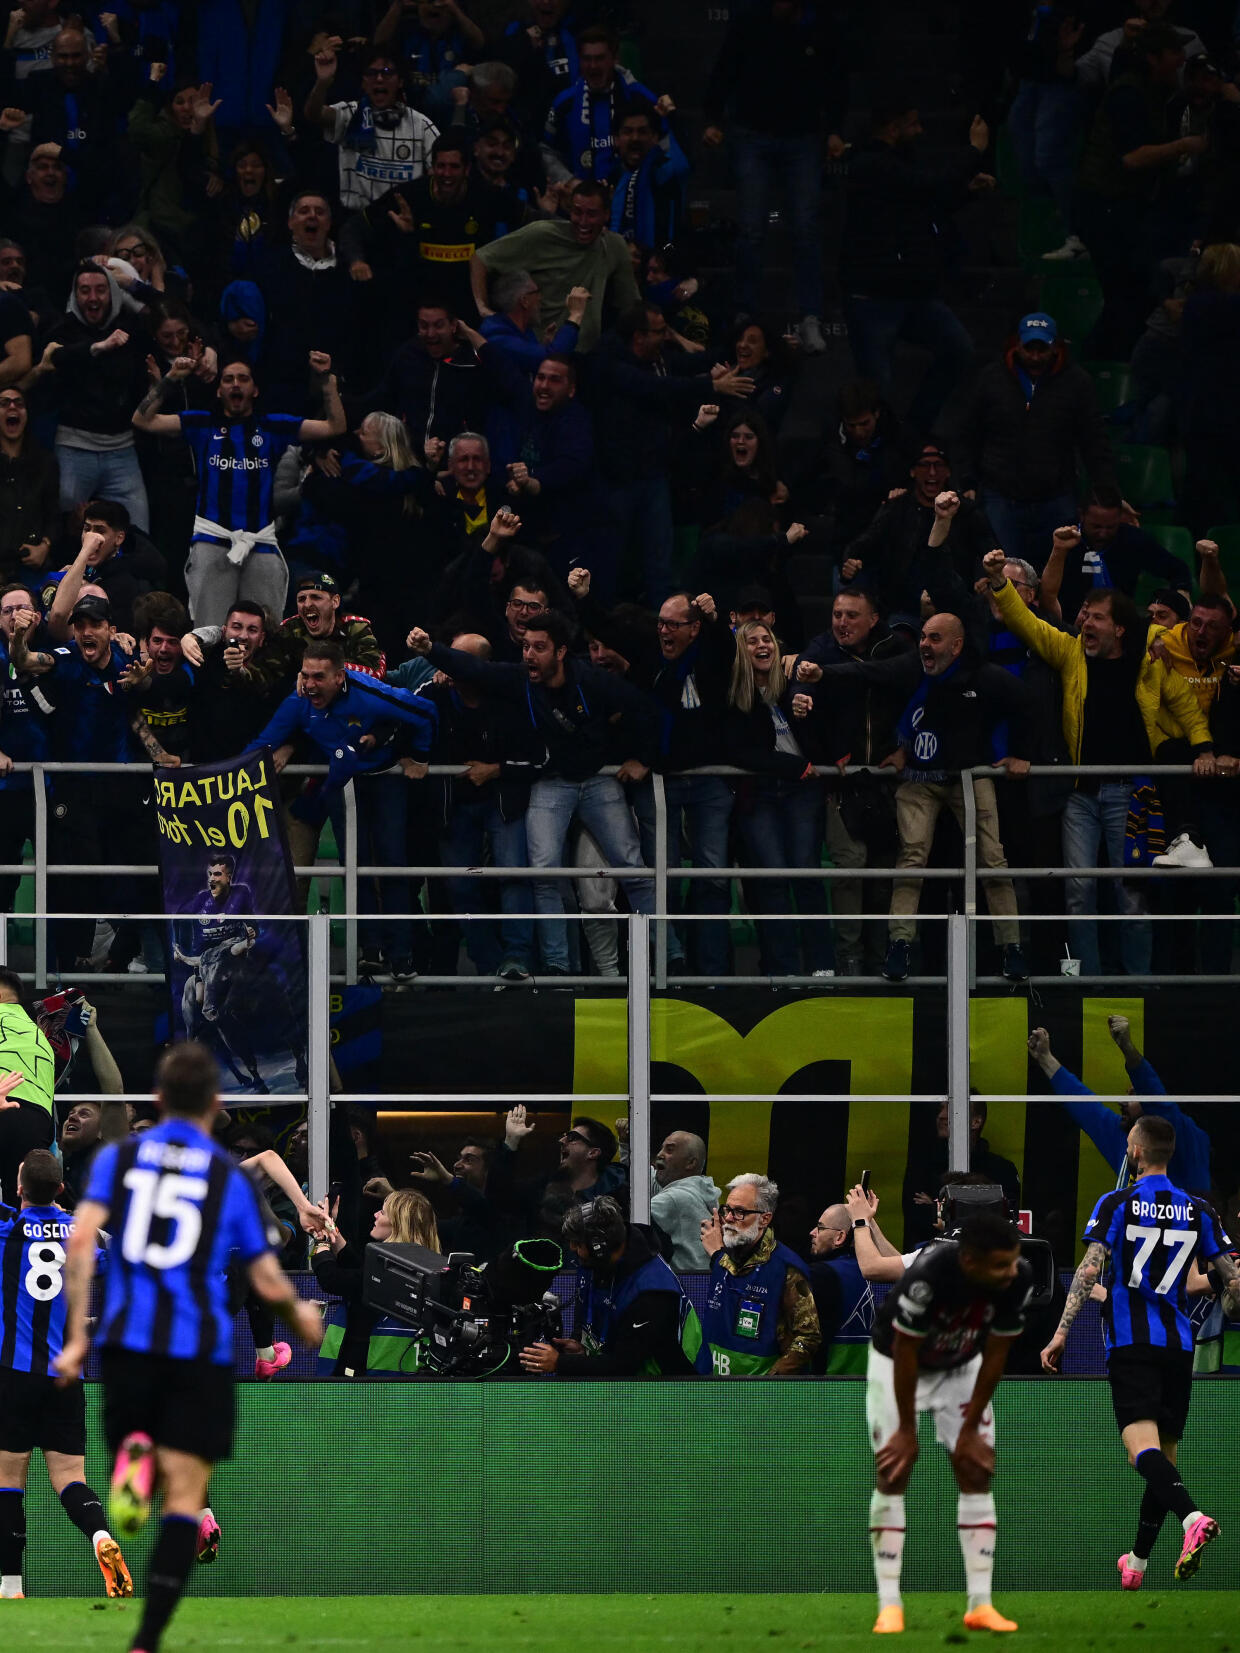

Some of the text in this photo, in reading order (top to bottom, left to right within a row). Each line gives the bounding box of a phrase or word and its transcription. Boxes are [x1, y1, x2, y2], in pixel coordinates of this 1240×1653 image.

[208, 454, 269, 470] digitalbits
[122, 1167, 210, 1270] 15
[1132, 1200, 1195, 1221] BROZOVIĆ
[25, 1241, 67, 1302] 8
[1126, 1224, 1198, 1295] 77
